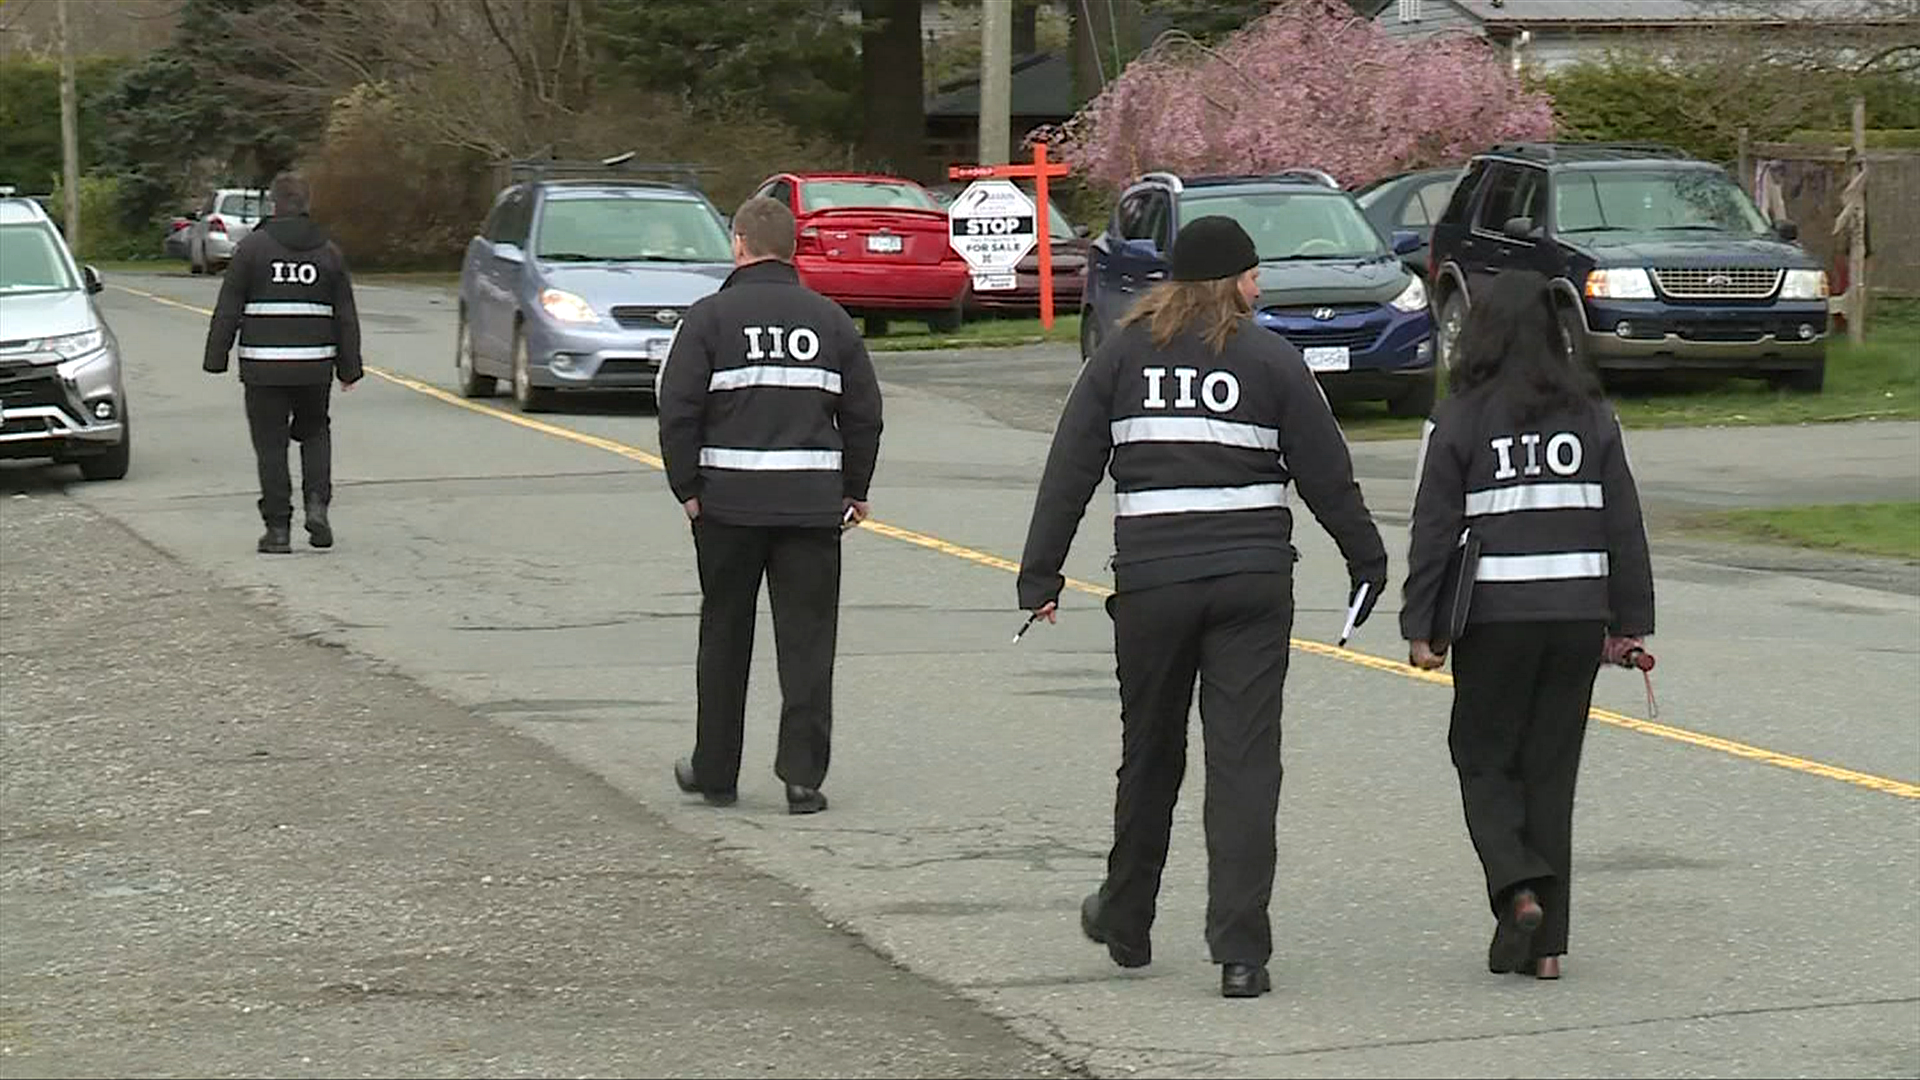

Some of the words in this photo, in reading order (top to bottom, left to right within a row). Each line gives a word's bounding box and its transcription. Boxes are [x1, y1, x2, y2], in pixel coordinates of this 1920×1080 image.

[966, 218, 1020, 234] STOP
[966, 243, 989, 252] FOR
[991, 243, 1020, 252] SALE
[271, 262, 317, 284] IIO
[744, 326, 820, 362] IIO
[1142, 367, 1240, 413] IIO
[1491, 432, 1584, 480] IIO
